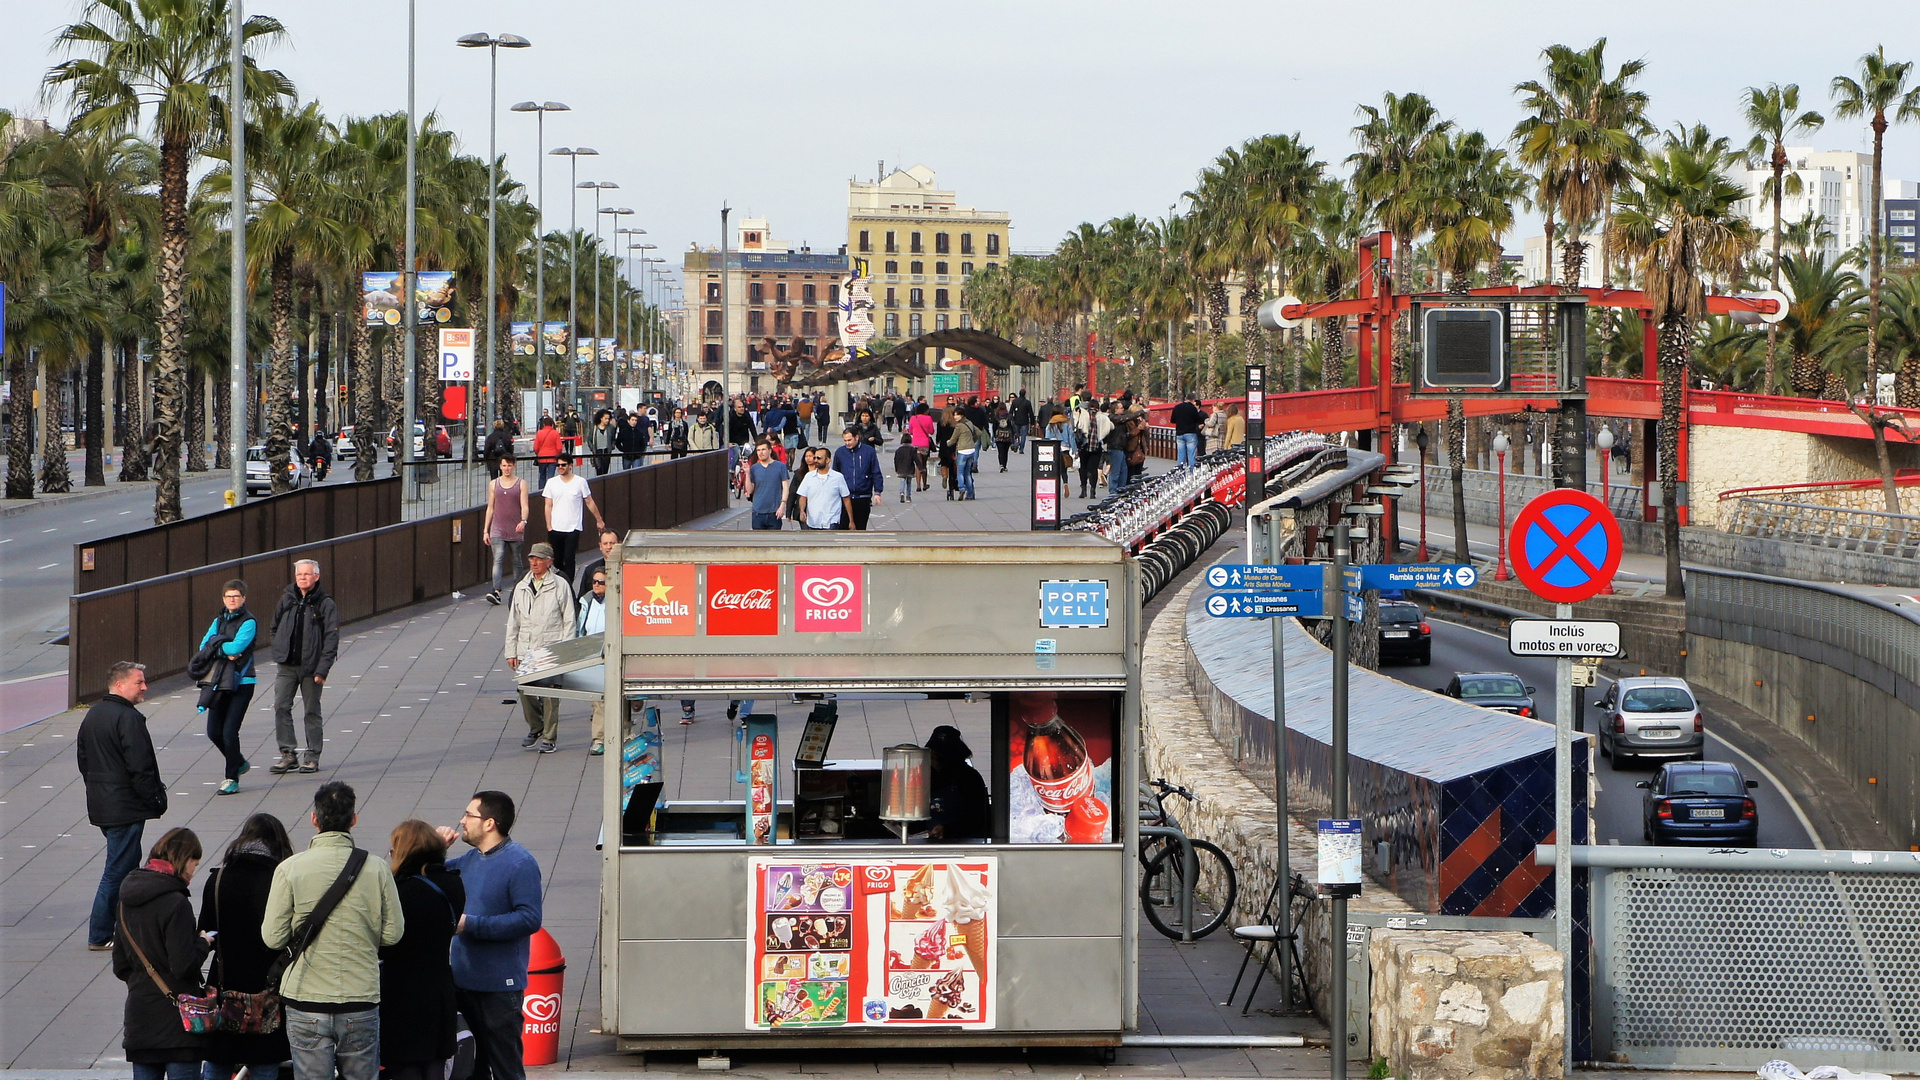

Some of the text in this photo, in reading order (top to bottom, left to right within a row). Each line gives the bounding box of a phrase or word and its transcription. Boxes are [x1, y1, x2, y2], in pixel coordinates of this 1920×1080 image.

[443, 352, 458, 378] P
[1243, 566, 1278, 574] La Rambla
[1415, 573, 1425, 581] de
[711, 588, 776, 610] Coca-Cola
[1048, 592, 1100, 602] PORT
[1254, 595, 1288, 603] Drassanes
[629, 599, 689, 616] Estrella
[1047, 605, 1100, 616] VELL
[646, 616, 672, 625] Damm
[1549, 624, 1585, 637] Inclús
[1519, 639, 1555, 651] motos
[1559, 642, 1572, 651] en
[889, 973, 931, 995] Cornetto
[899, 986, 921, 999] Soft
[524, 1022, 558, 1034] FRIGO
